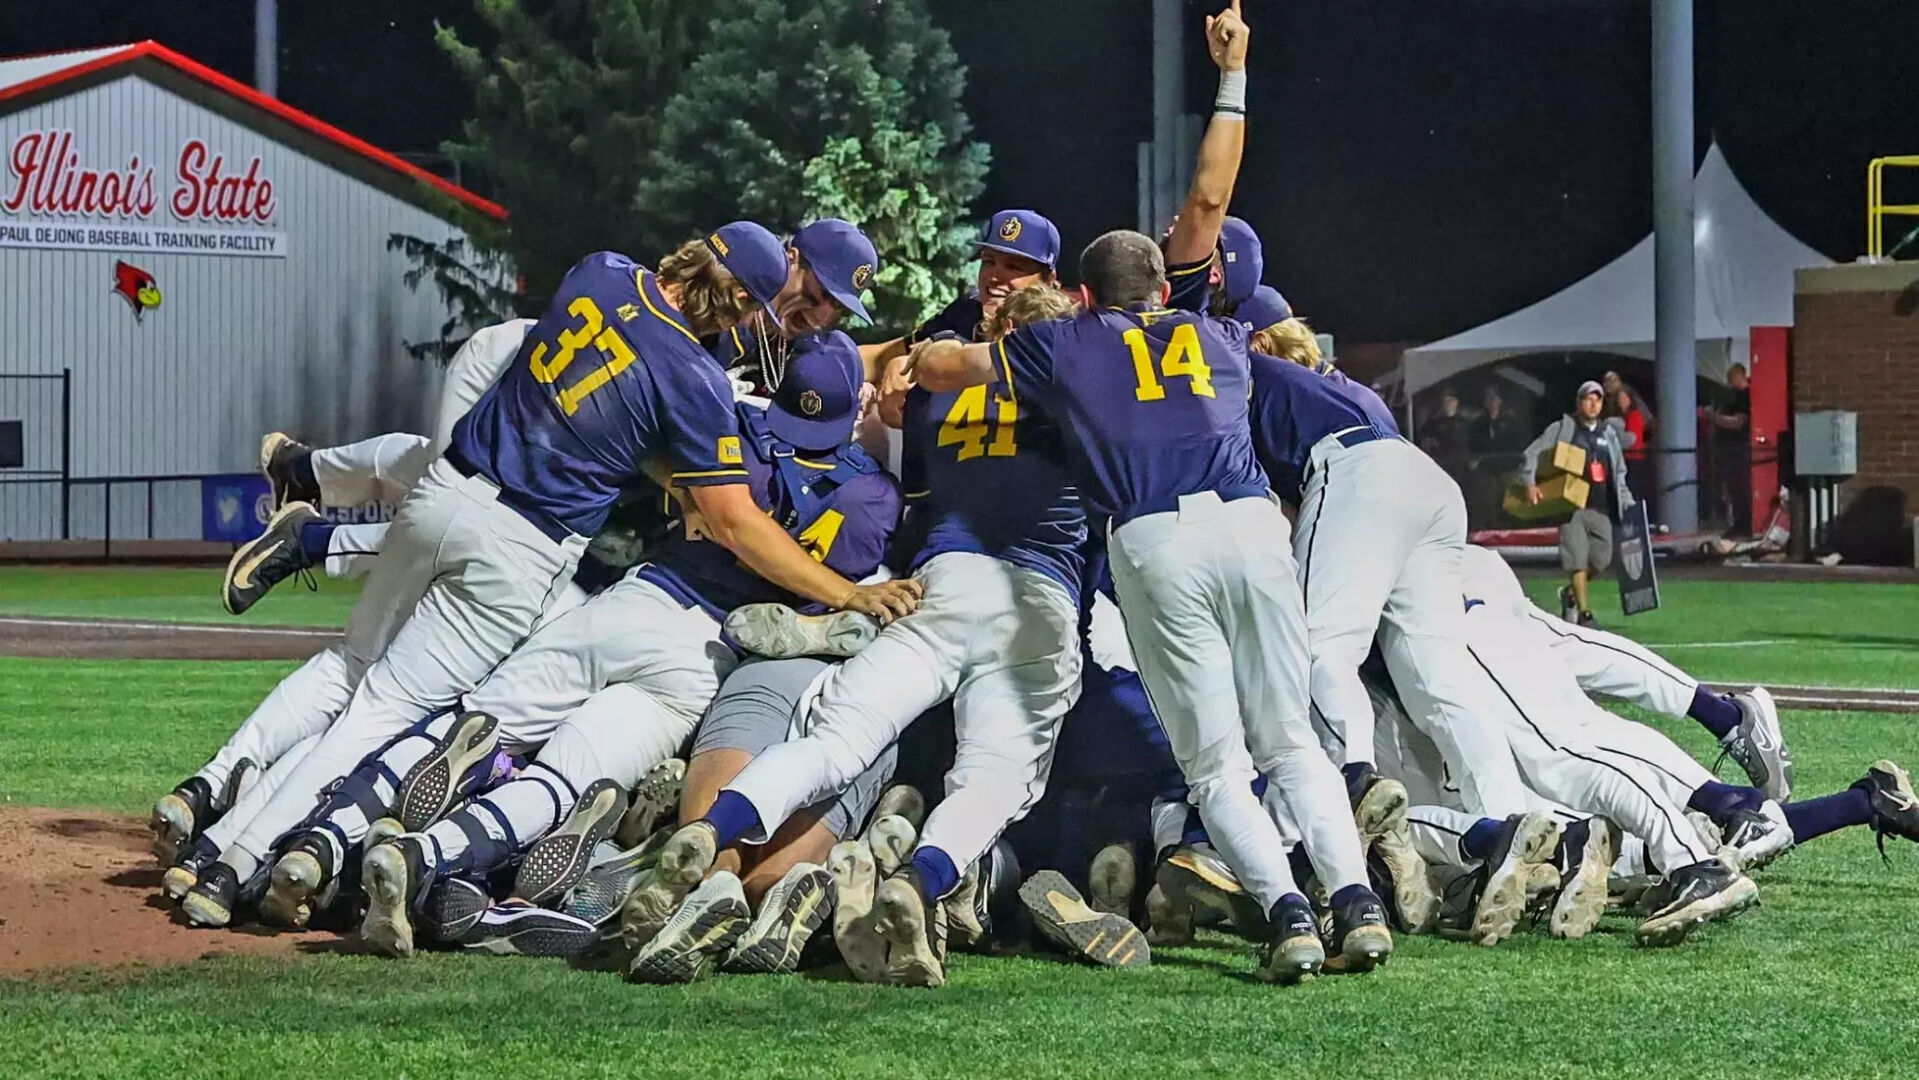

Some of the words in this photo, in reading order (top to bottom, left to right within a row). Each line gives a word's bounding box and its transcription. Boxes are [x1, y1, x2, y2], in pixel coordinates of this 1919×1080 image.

[3, 131, 157, 216] Illinois
[172, 138, 277, 222] State
[0, 226, 32, 242] PAUL
[36, 227, 85, 244] DEJONG
[88, 230, 151, 247] BASEBALL
[154, 231, 216, 249] TRAINING
[220, 235, 276, 251] FACILITY
[529, 296, 637, 417] 37
[1122, 323, 1217, 402] 14
[937, 383, 1018, 462] 41
